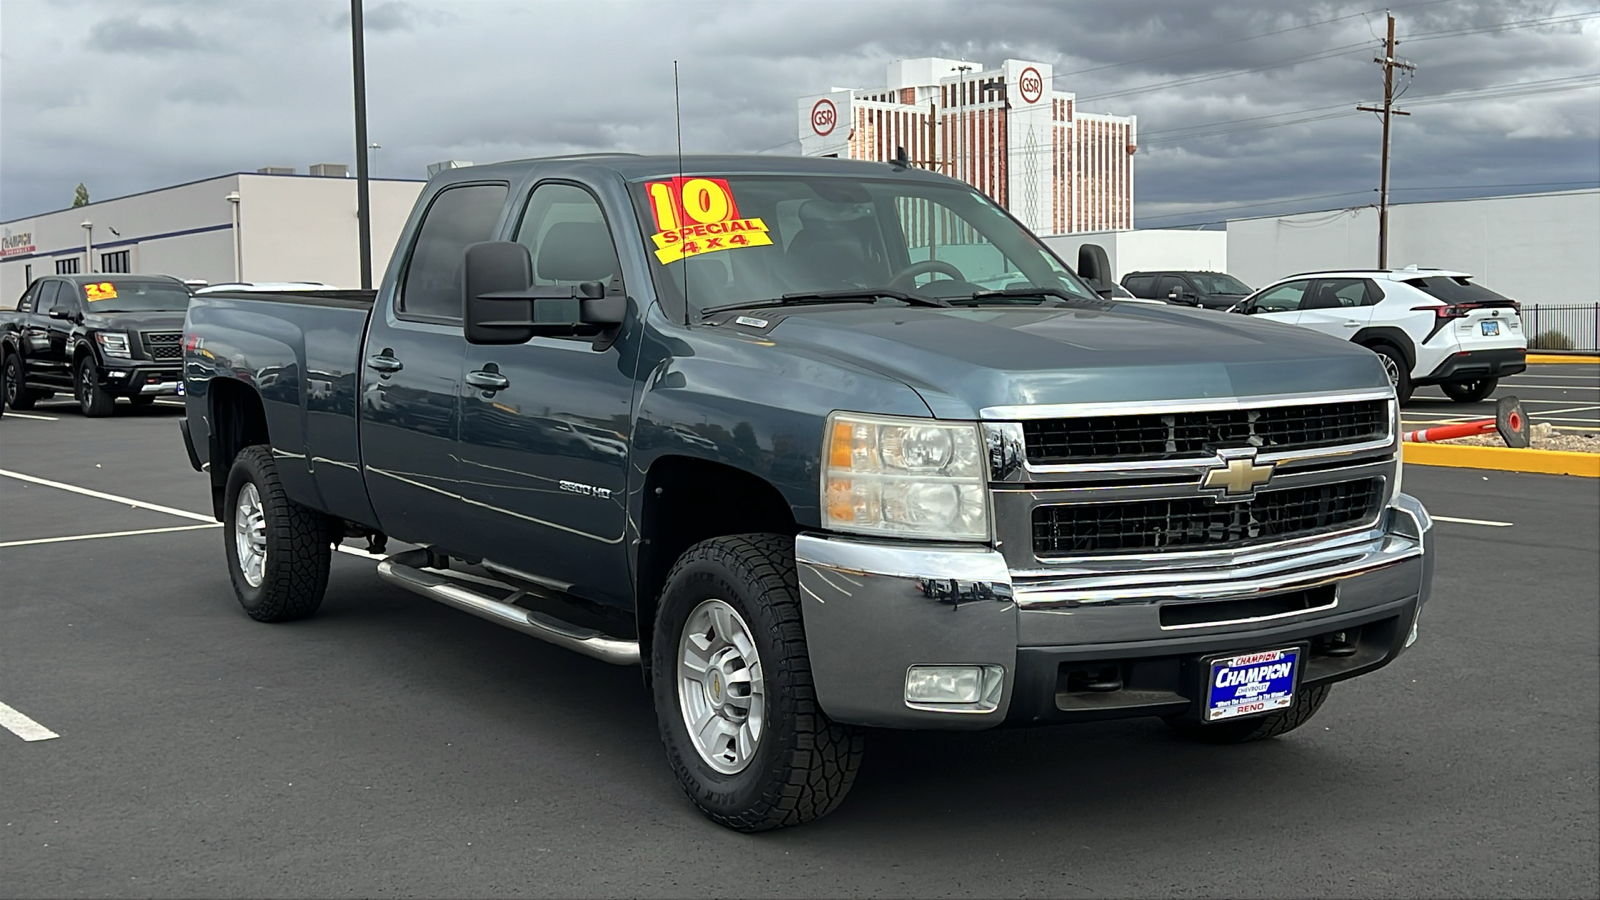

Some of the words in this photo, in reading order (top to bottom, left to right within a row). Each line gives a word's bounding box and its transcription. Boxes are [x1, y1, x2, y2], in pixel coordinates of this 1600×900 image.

[1022, 77, 1039, 93] GSR
[814, 109, 833, 126] GSR
[651, 179, 733, 231] 10
[663, 220, 762, 243] SPECIAL
[593, 487, 612, 499] HD
[1235, 652, 1277, 666] CHAMPION
[1238, 684, 1267, 694] CHEVROLET
[1237, 702, 1264, 713] RENO
